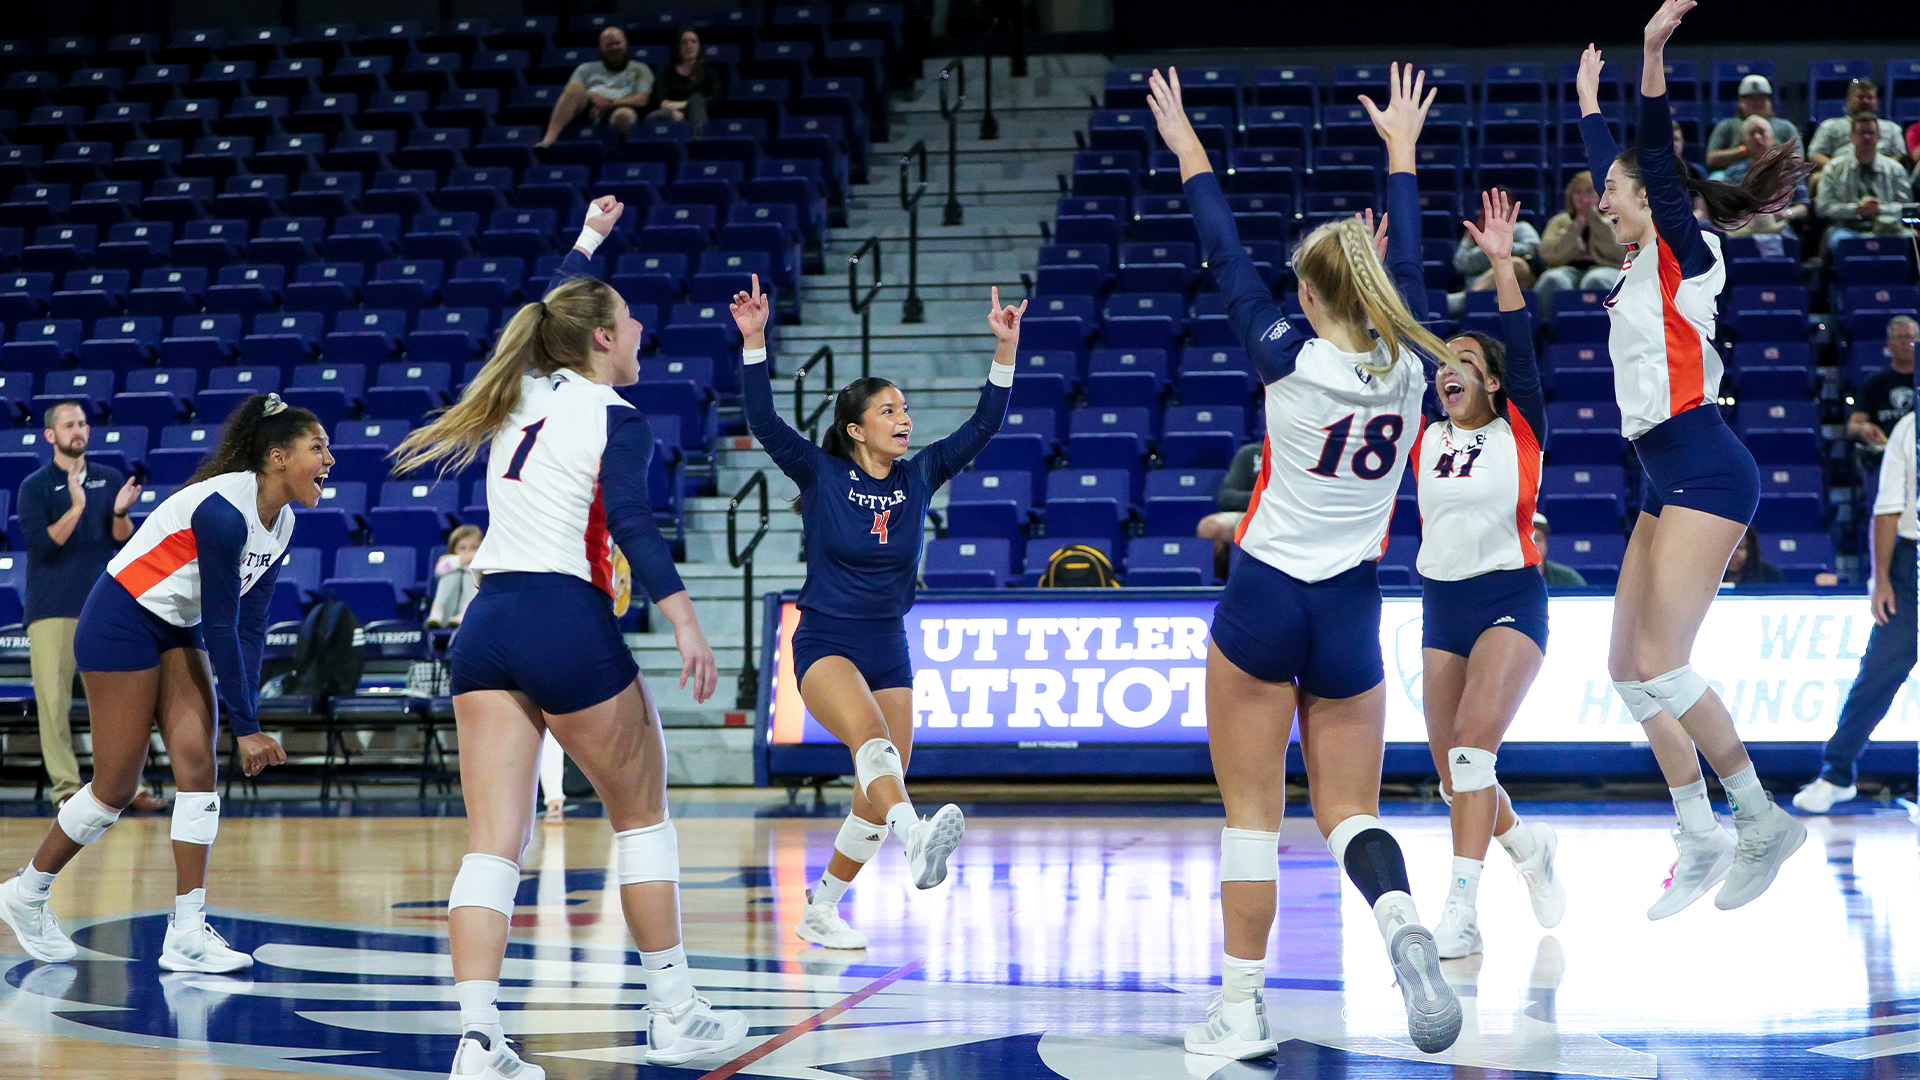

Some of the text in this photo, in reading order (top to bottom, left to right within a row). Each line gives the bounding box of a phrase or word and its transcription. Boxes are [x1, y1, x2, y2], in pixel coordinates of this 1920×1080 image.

[502, 416, 548, 482] 1
[1305, 412, 1404, 480] 18
[870, 509, 891, 544] 4
[0, 636, 31, 648] ATRIO
[265, 633, 298, 646] PATR
[920, 617, 1208, 662] UT TYLER
[1760, 614, 1862, 660] WEL
[912, 667, 1208, 728] ATRIOT
